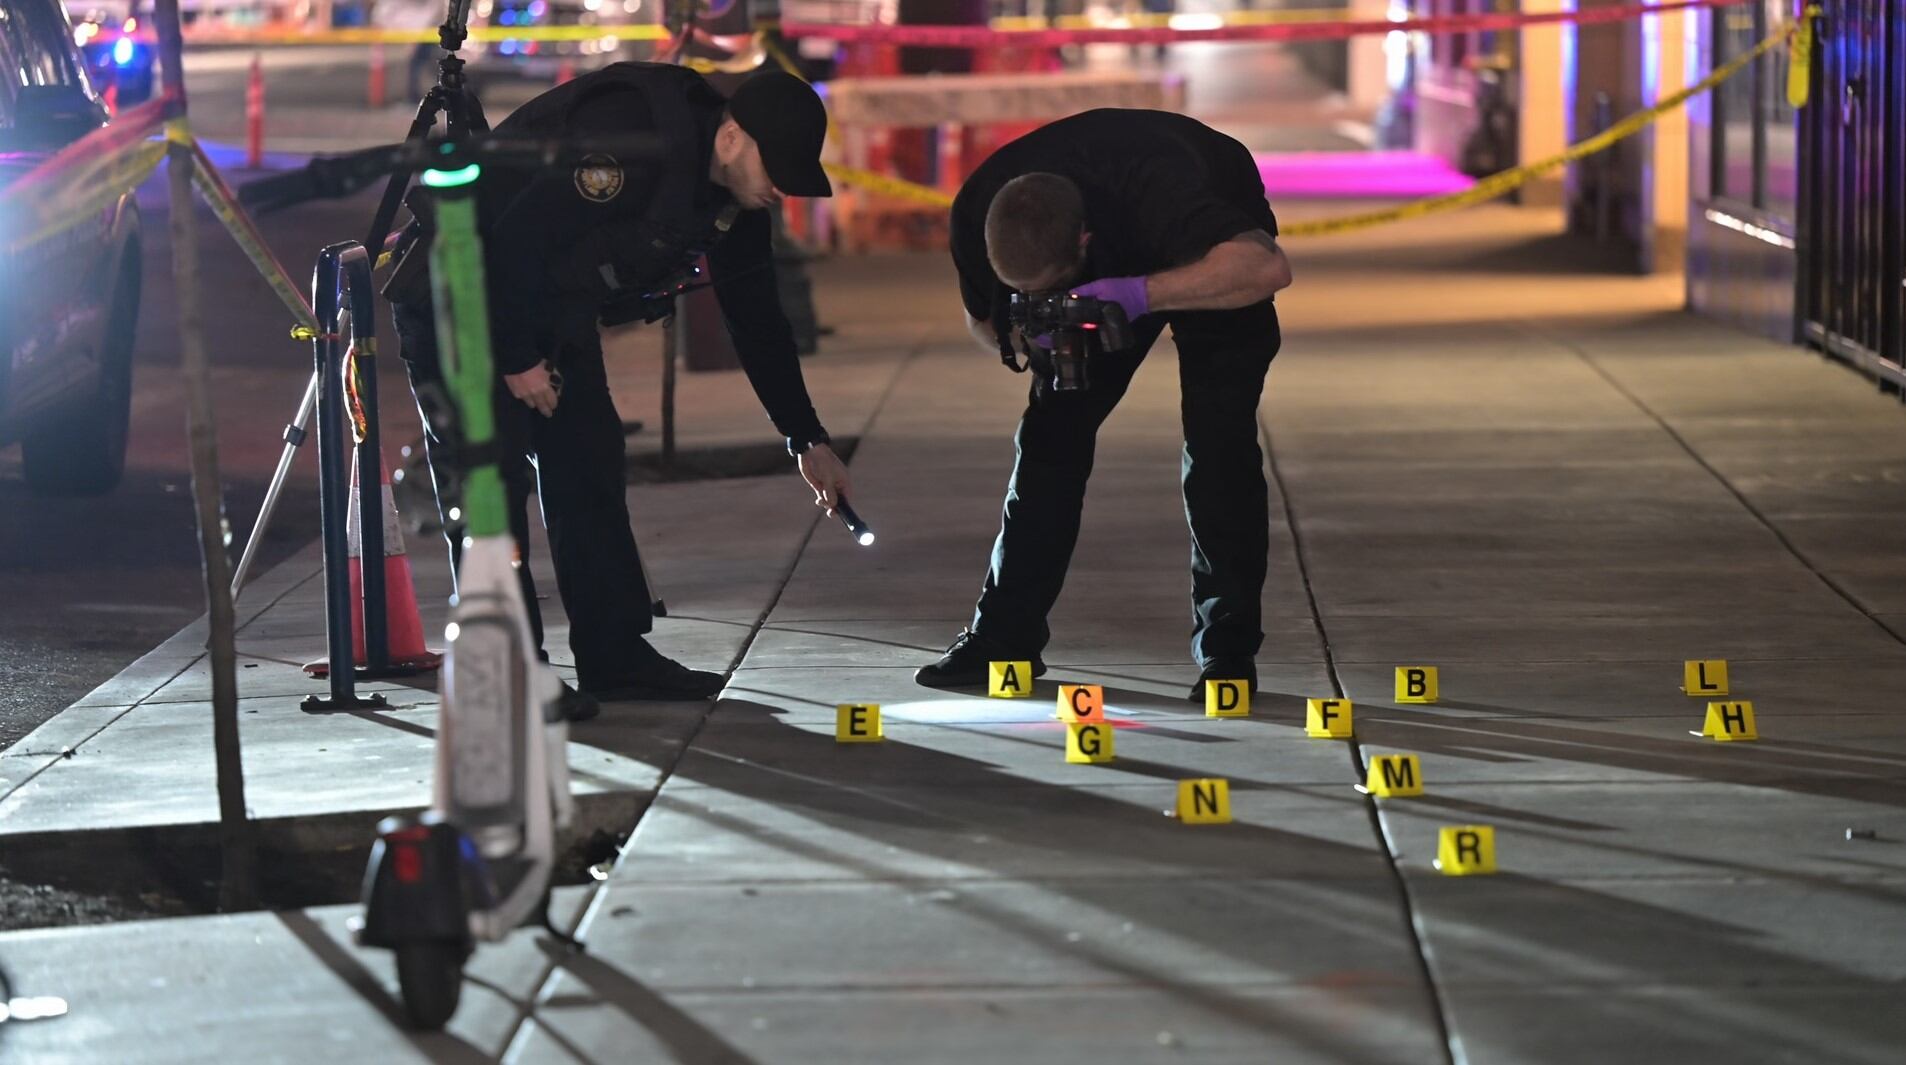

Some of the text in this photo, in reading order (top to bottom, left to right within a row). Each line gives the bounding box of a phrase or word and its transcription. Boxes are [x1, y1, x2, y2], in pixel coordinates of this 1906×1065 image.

[1001, 664, 1020, 691] A
[1407, 669, 1426, 696] B
[1699, 662, 1718, 690] L
[1073, 688, 1091, 716] C
[1217, 683, 1239, 710] D
[849, 706, 867, 735] E
[1322, 701, 1339, 729] F
[1721, 704, 1746, 733] H
[1078, 726, 1100, 755] G
[1382, 758, 1414, 788] M
[1193, 784, 1218, 815] N
[1456, 831, 1482, 865] R
